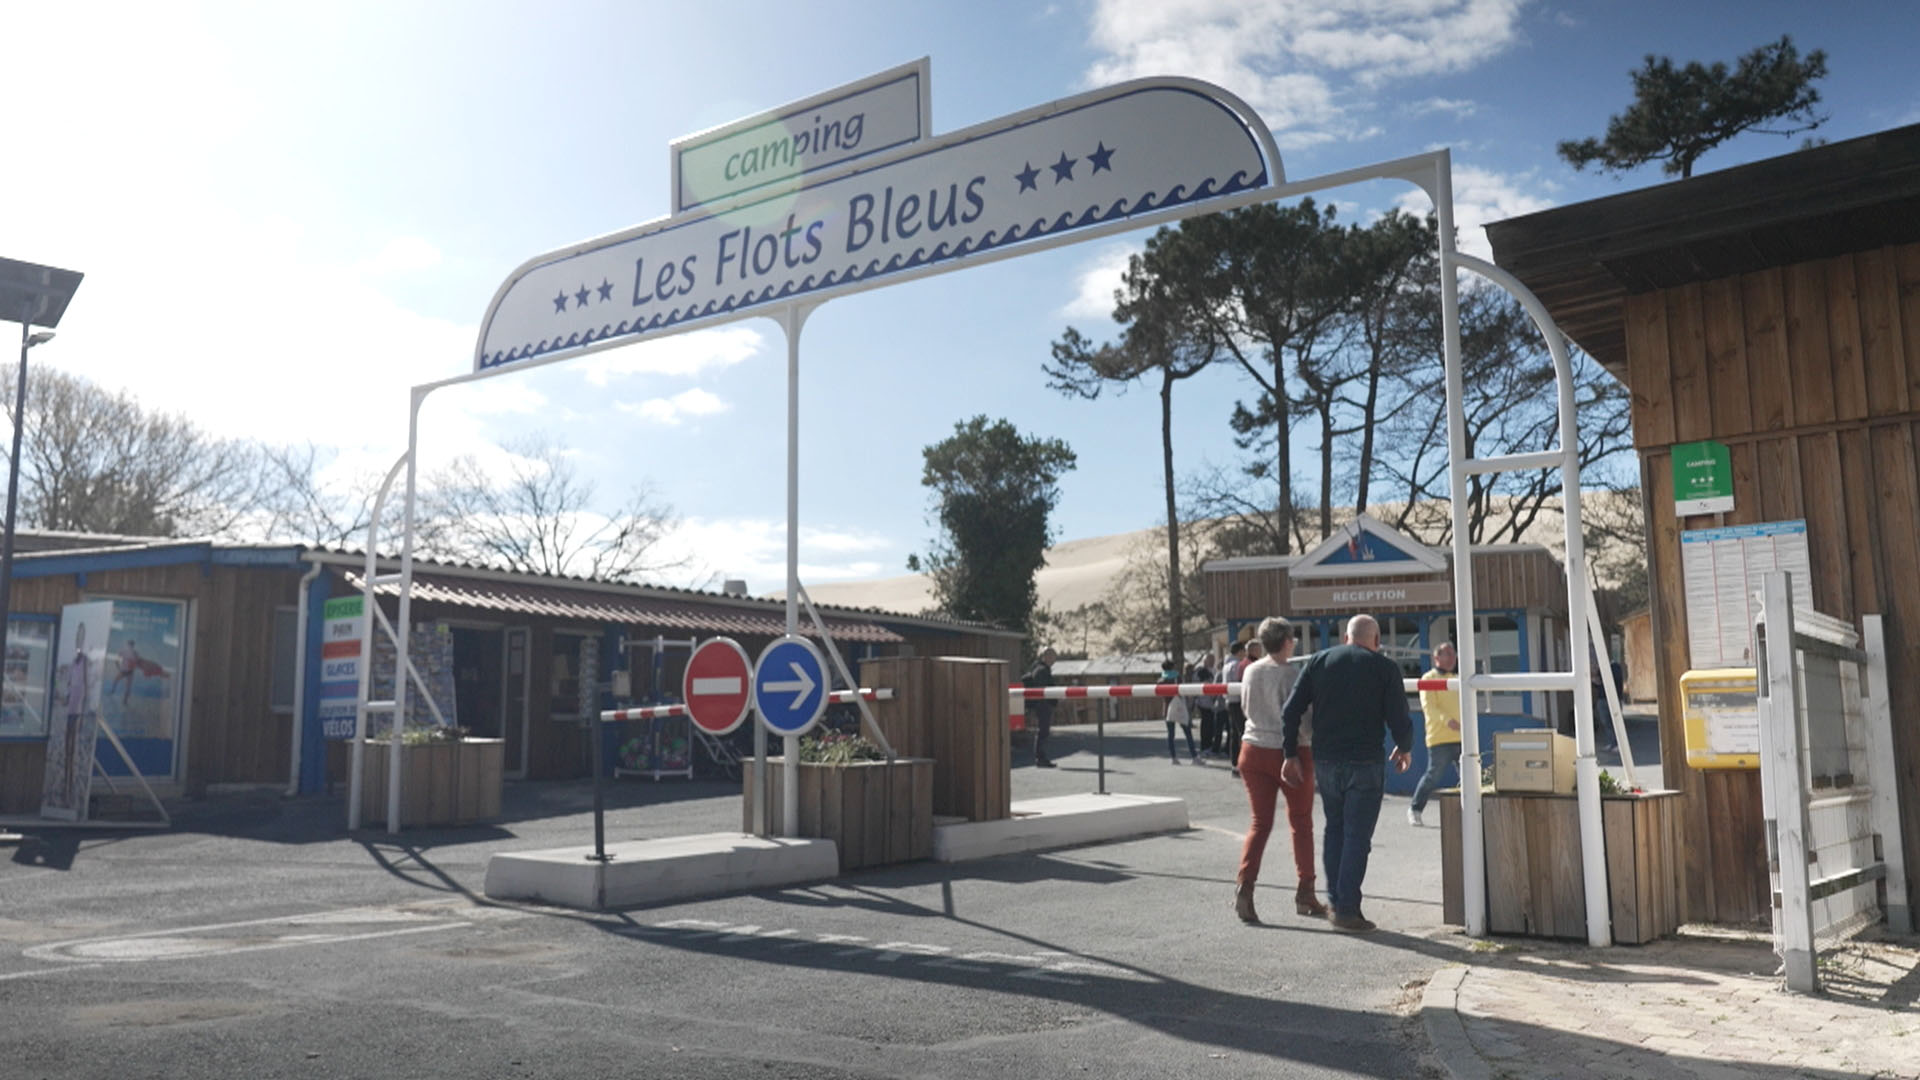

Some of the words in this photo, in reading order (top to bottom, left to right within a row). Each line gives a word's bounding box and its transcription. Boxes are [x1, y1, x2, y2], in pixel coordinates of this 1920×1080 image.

[725, 113, 865, 181] camping
[631, 255, 697, 307] Les
[715, 213, 824, 286] Flots
[846, 175, 986, 254] Bleus
[327, 663, 355, 677] GLACES
